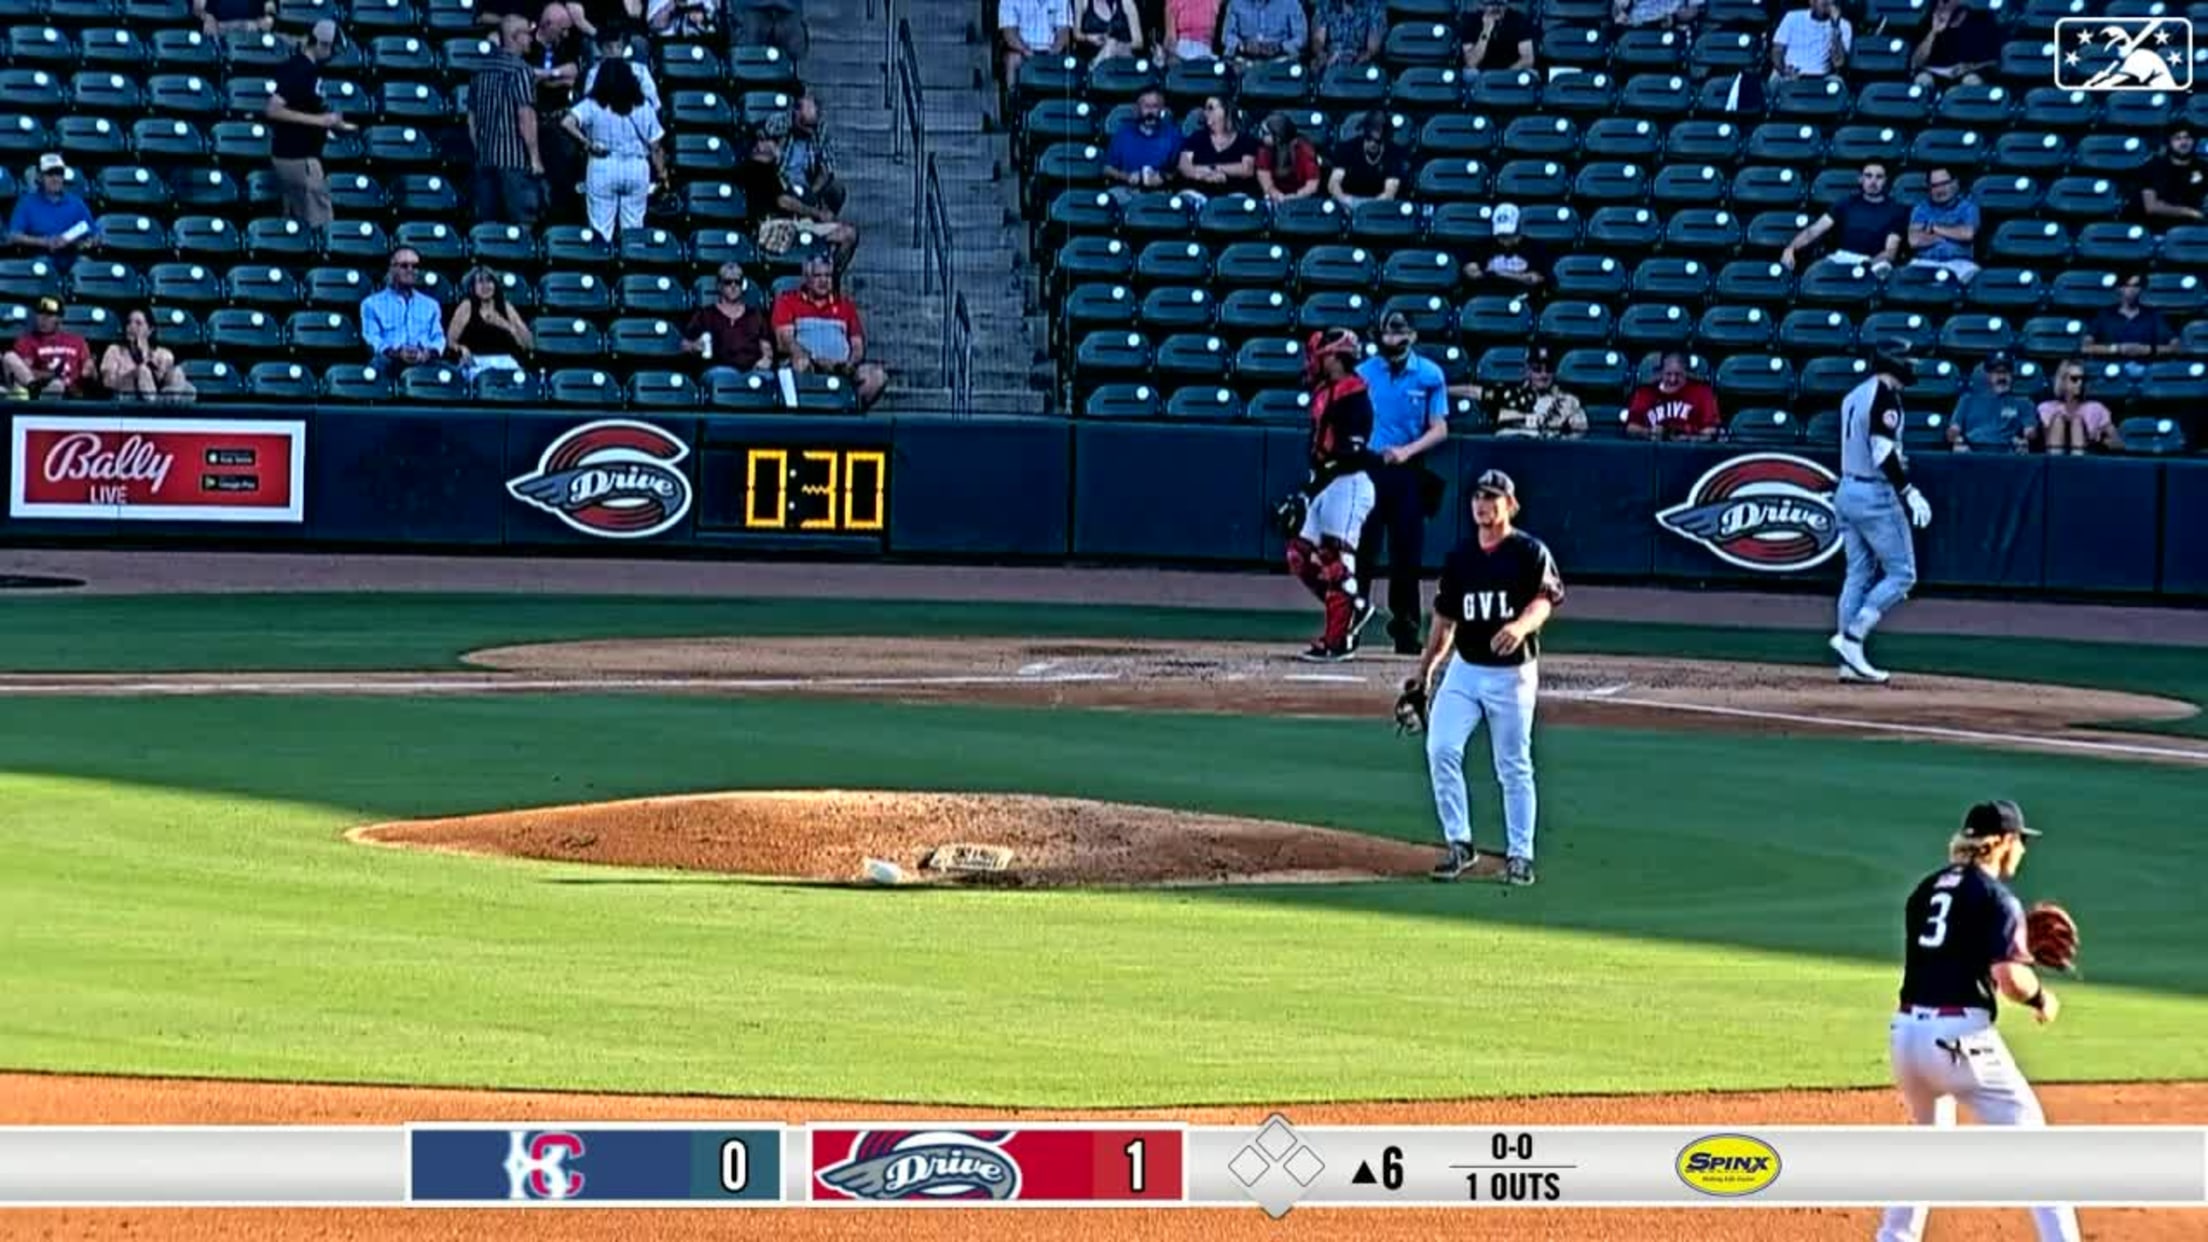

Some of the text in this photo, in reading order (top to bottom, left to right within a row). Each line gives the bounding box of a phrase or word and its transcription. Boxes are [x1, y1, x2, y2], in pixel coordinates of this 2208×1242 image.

[1647, 400, 1692, 427] DRIVE
[44, 433, 173, 493] Bally
[90, 485, 128, 504] LIVE
[570, 465, 675, 503] Drive
[746, 449, 885, 529] 0:30
[1721, 500, 1828, 534] Drive
[1463, 591, 1514, 621] GVL
[1918, 892, 1952, 946] 3
